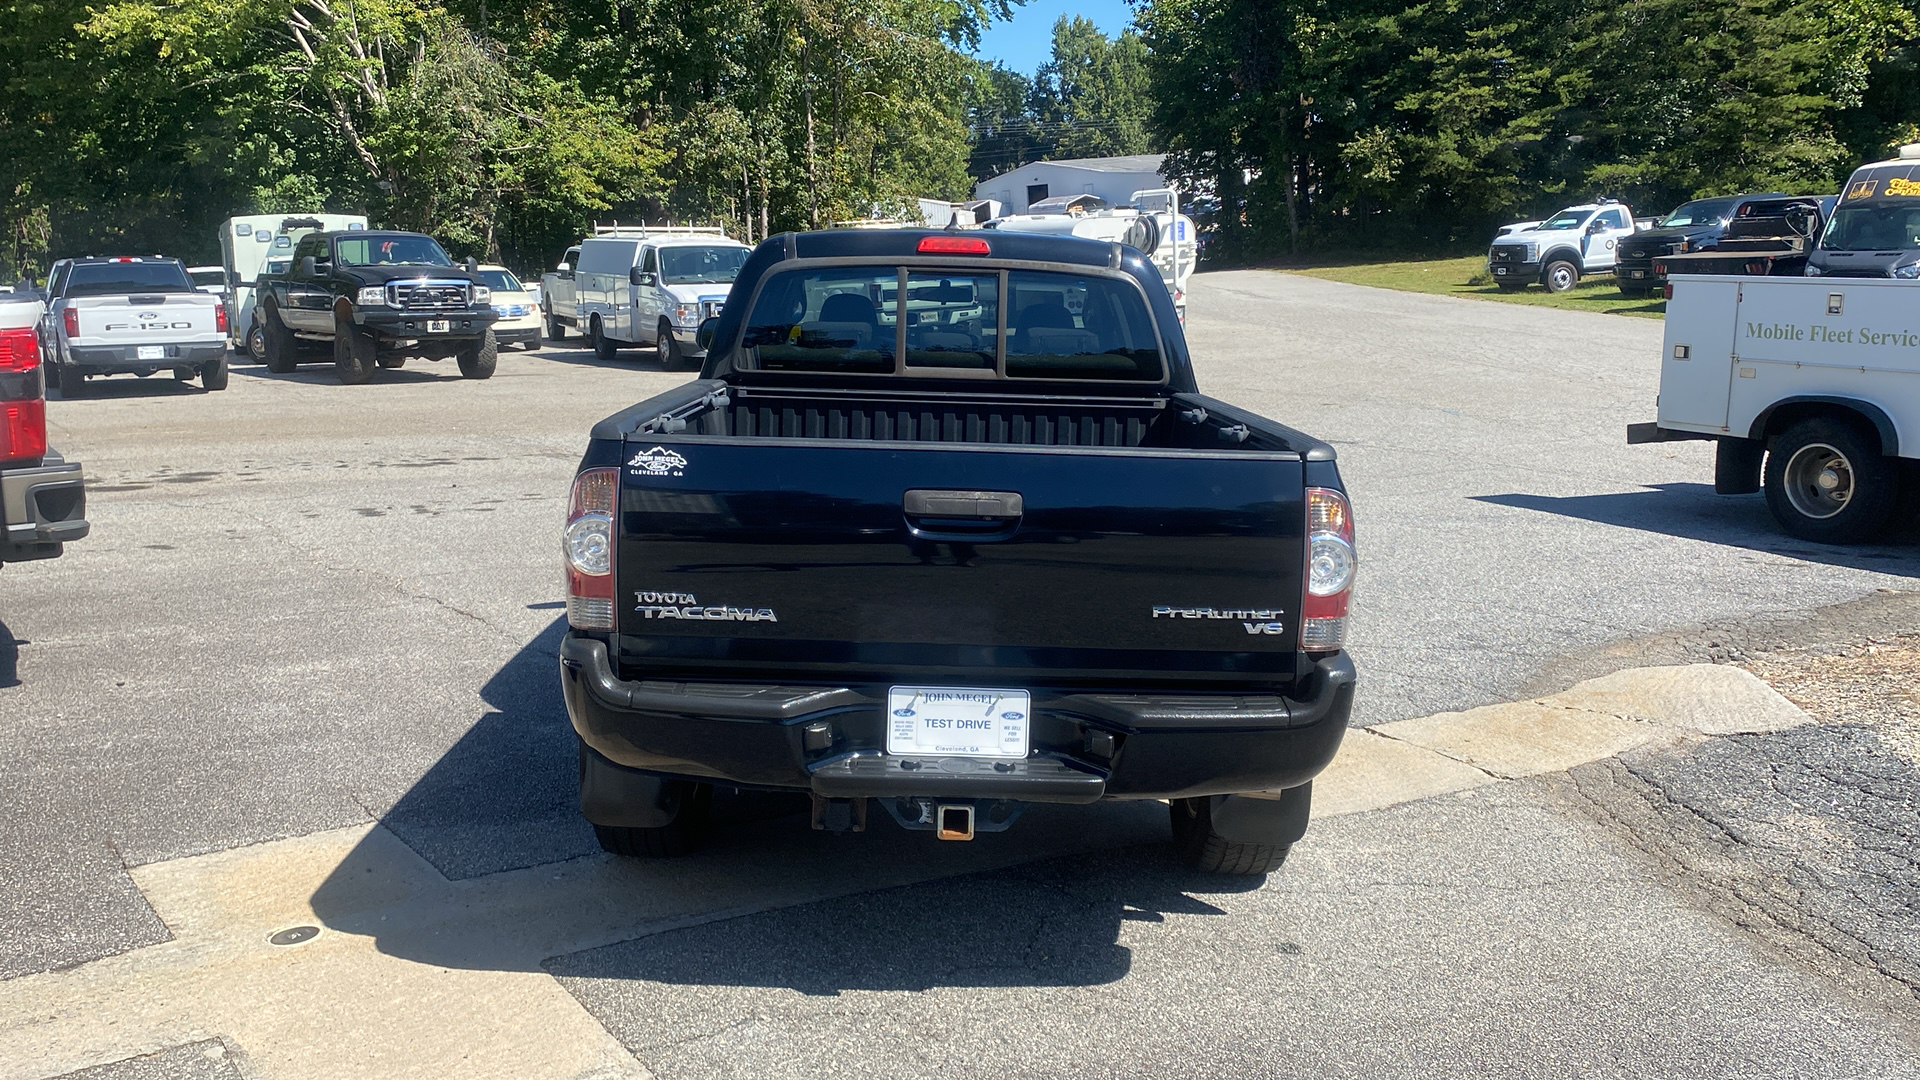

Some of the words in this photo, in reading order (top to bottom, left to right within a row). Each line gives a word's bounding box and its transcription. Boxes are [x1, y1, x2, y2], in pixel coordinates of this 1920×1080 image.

[432, 322, 445, 330] CAT
[1745, 322, 1804, 341] Mobile
[1809, 325, 1853, 344] Fleet
[1858, 327, 1920, 347] Servic
[634, 455, 653, 463] JOHN
[634, 592, 697, 605] TOYOTA
[634, 606, 778, 622] TACOMA
[1152, 605, 1284, 619] PreRunner
[1243, 622, 1284, 635] V6
[923, 692, 953, 704] JOHN
[895, 709, 914, 717] Ford
[1002, 711, 1022, 720] Ford
[924, 719, 953, 729] TEST
[956, 720, 991, 730] DRIVE
[935, 745, 969, 753] Cleveland,
